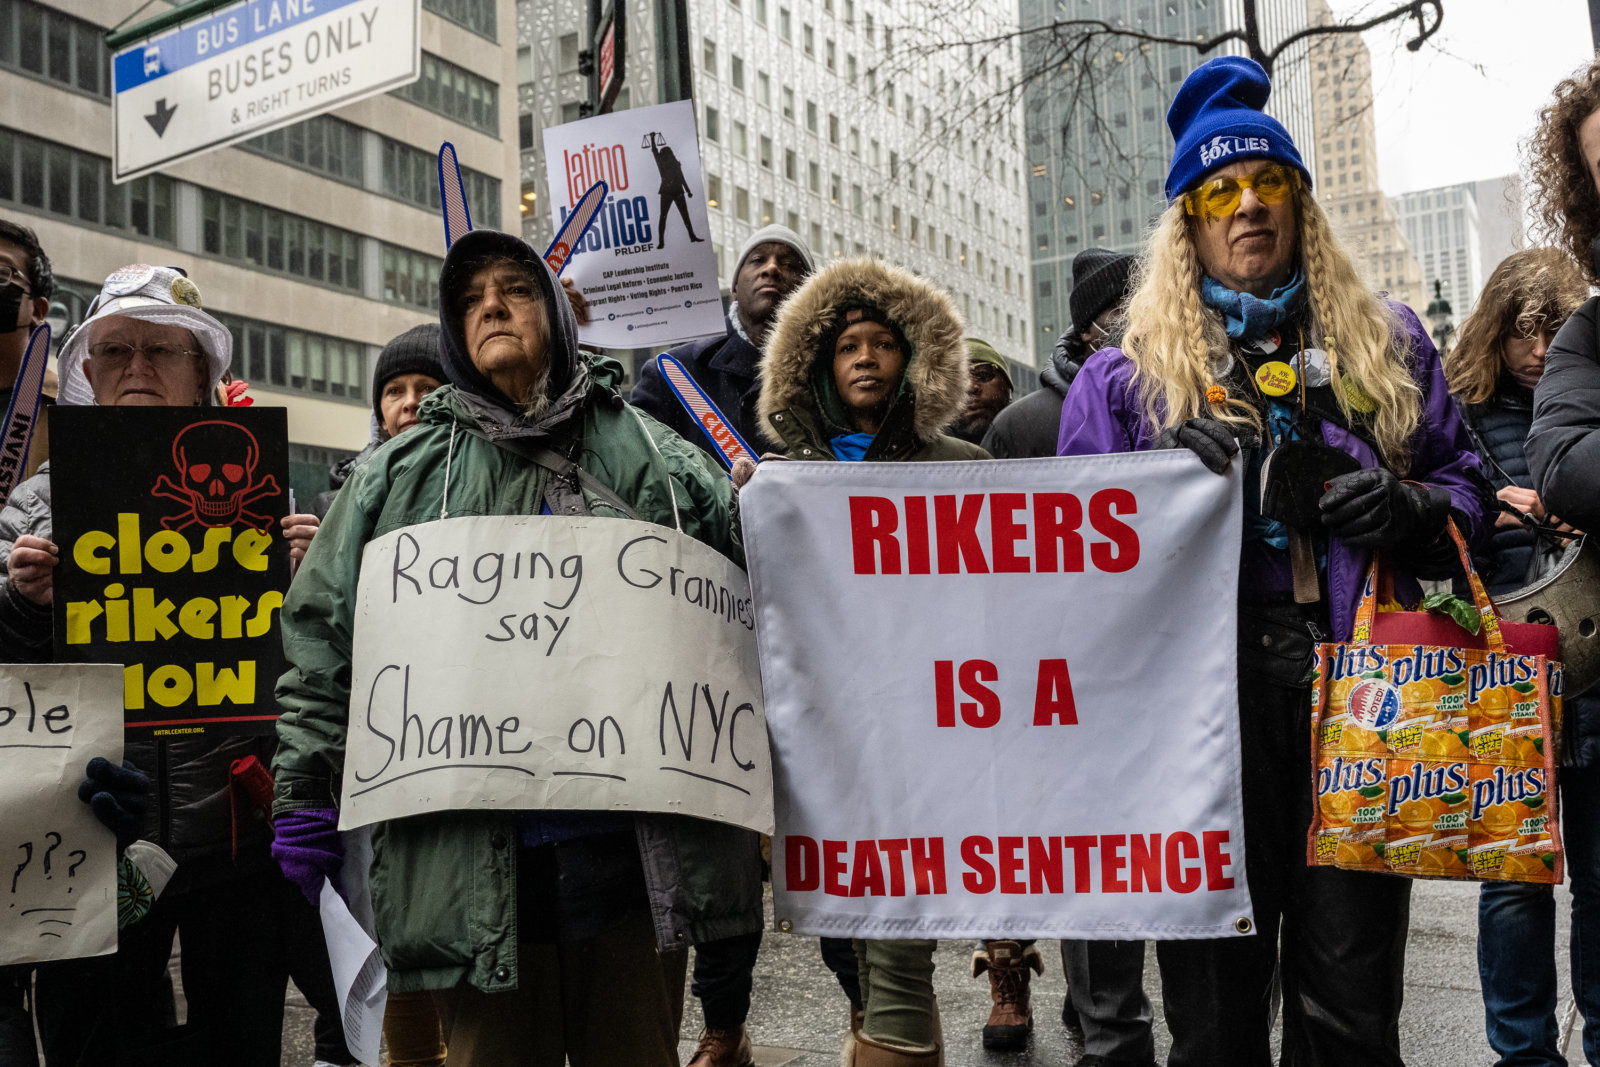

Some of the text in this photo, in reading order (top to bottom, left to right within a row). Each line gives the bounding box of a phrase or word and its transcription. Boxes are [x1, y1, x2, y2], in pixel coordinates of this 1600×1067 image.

[197, 0, 315, 54] BUS LANE
[208, 6, 379, 101] BUSES ONLY
[231, 67, 351, 124] & RIGHT TURNS
[1200, 137, 1270, 167] FOX LIES
[602, 262, 670, 279] CAP Leadership Institute
[614, 243, 654, 256] PRLDEF
[582, 271, 694, 295] Criminal Legal Reform Economic Justice
[608, 293, 626, 304] Rights
[630, 290, 648, 301] Voting
[648, 287, 667, 299] Rights
[671, 284, 689, 294] Puerto
[690, 281, 703, 290] Rico
[702, 411, 743, 458] CUT!
[73, 513, 273, 575] close
[848, 487, 1141, 576] RIKERS
[393, 533, 755, 630] Raging Grannies
[66, 583, 284, 644] rikers
[485, 613, 570, 656] say
[934, 658, 1079, 729] IS A
[1367, 687, 1385, 718] VOTED!
[153, 727, 205, 737] KATALCENTER.ORG
[355, 664, 755, 782] Shame on NYC
[1434, 822, 1464, 830] VITAMIN
[785, 830, 1235, 898] DEATH SENTENCE
